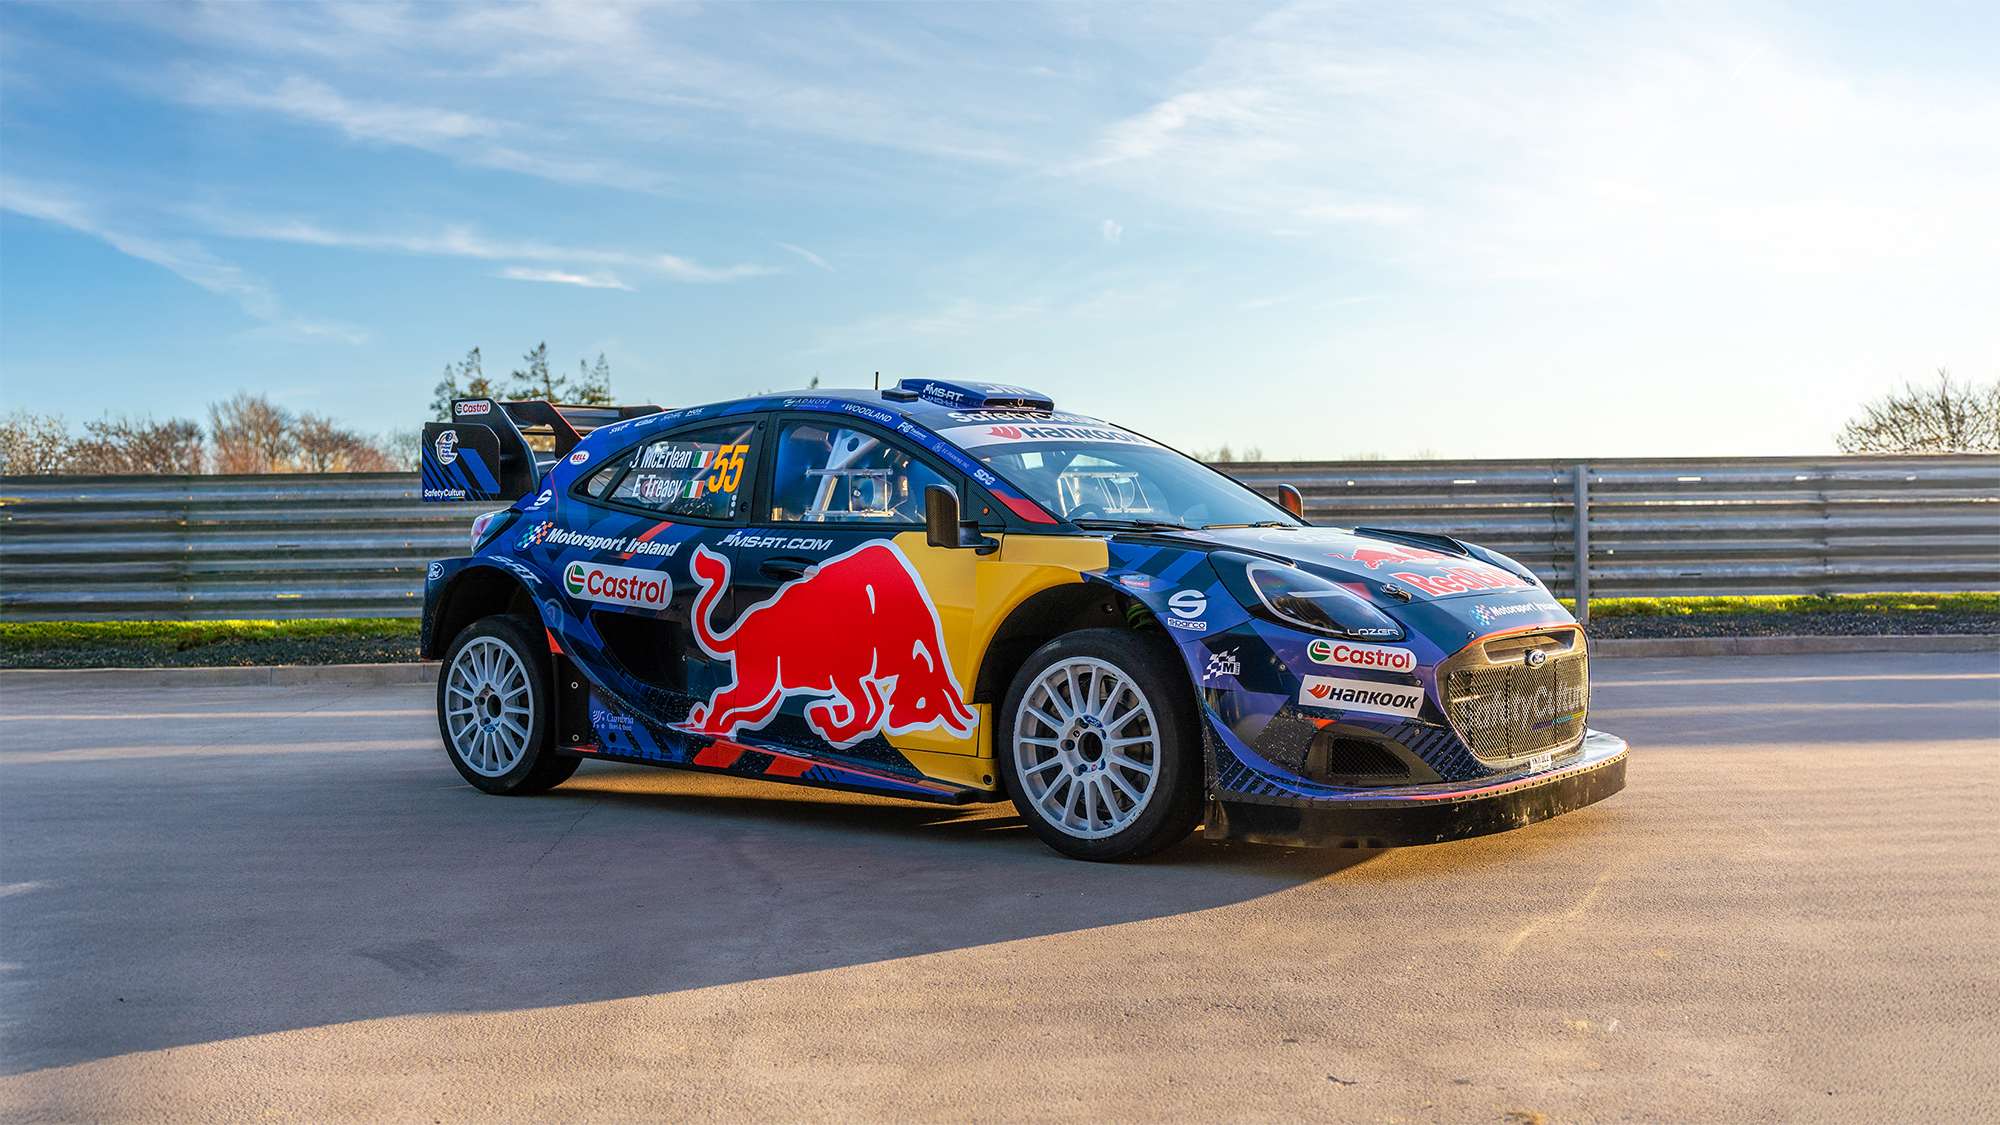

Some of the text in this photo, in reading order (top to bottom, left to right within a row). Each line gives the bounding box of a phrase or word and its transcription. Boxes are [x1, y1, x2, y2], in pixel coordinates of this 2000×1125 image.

[462, 401, 490, 414] Castrol
[843, 403, 894, 423] WOODLAND
[571, 453, 589, 462] BELL
[629, 445, 691, 469] J McErlean
[708, 444, 750, 493] 55
[424, 489, 466, 499] SafetyCulture
[632, 475, 683, 502] E Treacy
[549, 527, 681, 558] Motorsport Ireland
[587, 570, 667, 604] Castrol
[1333, 645, 1411, 670] Castrol
